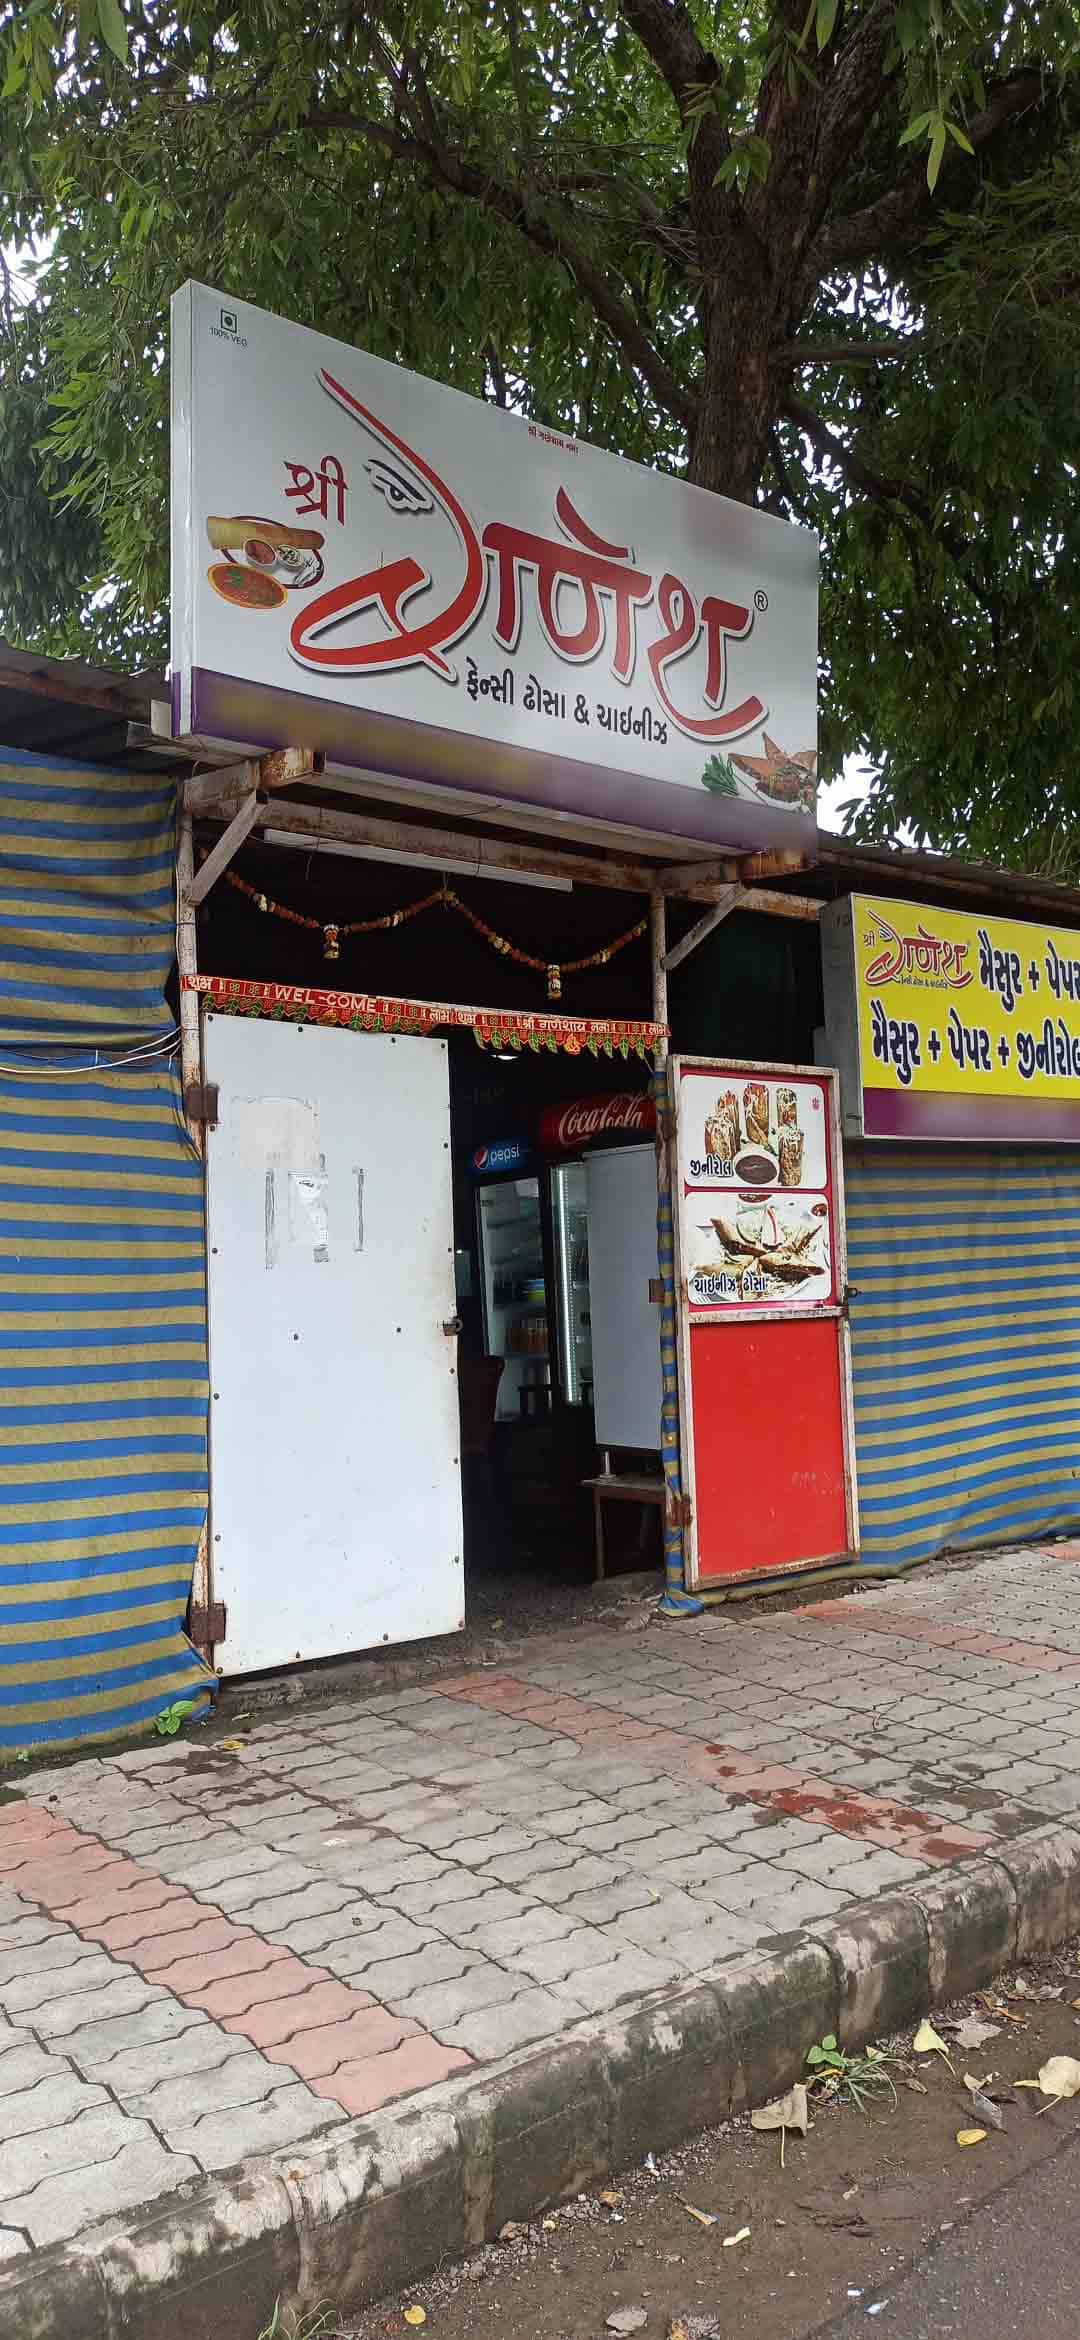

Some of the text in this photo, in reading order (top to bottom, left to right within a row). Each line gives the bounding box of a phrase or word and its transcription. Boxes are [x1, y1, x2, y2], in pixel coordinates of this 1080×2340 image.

[466, 656, 514, 704] ફેન્સી
[523, 673, 566, 719] ઢોસા
[574, 694, 590, 726] &
[977, 929, 1022, 1012] મૈસુર
[1028, 961, 1040, 991] +
[870, 999, 920, 1084] મૈસુર
[928, 1030, 940, 1061] +
[948, 1007, 992, 1070] પેપર
[998, 1036, 1010, 1066] +
[489, 1143, 520, 1166] pepsi
[690, 1154, 731, 1177] જીનીરોલ
